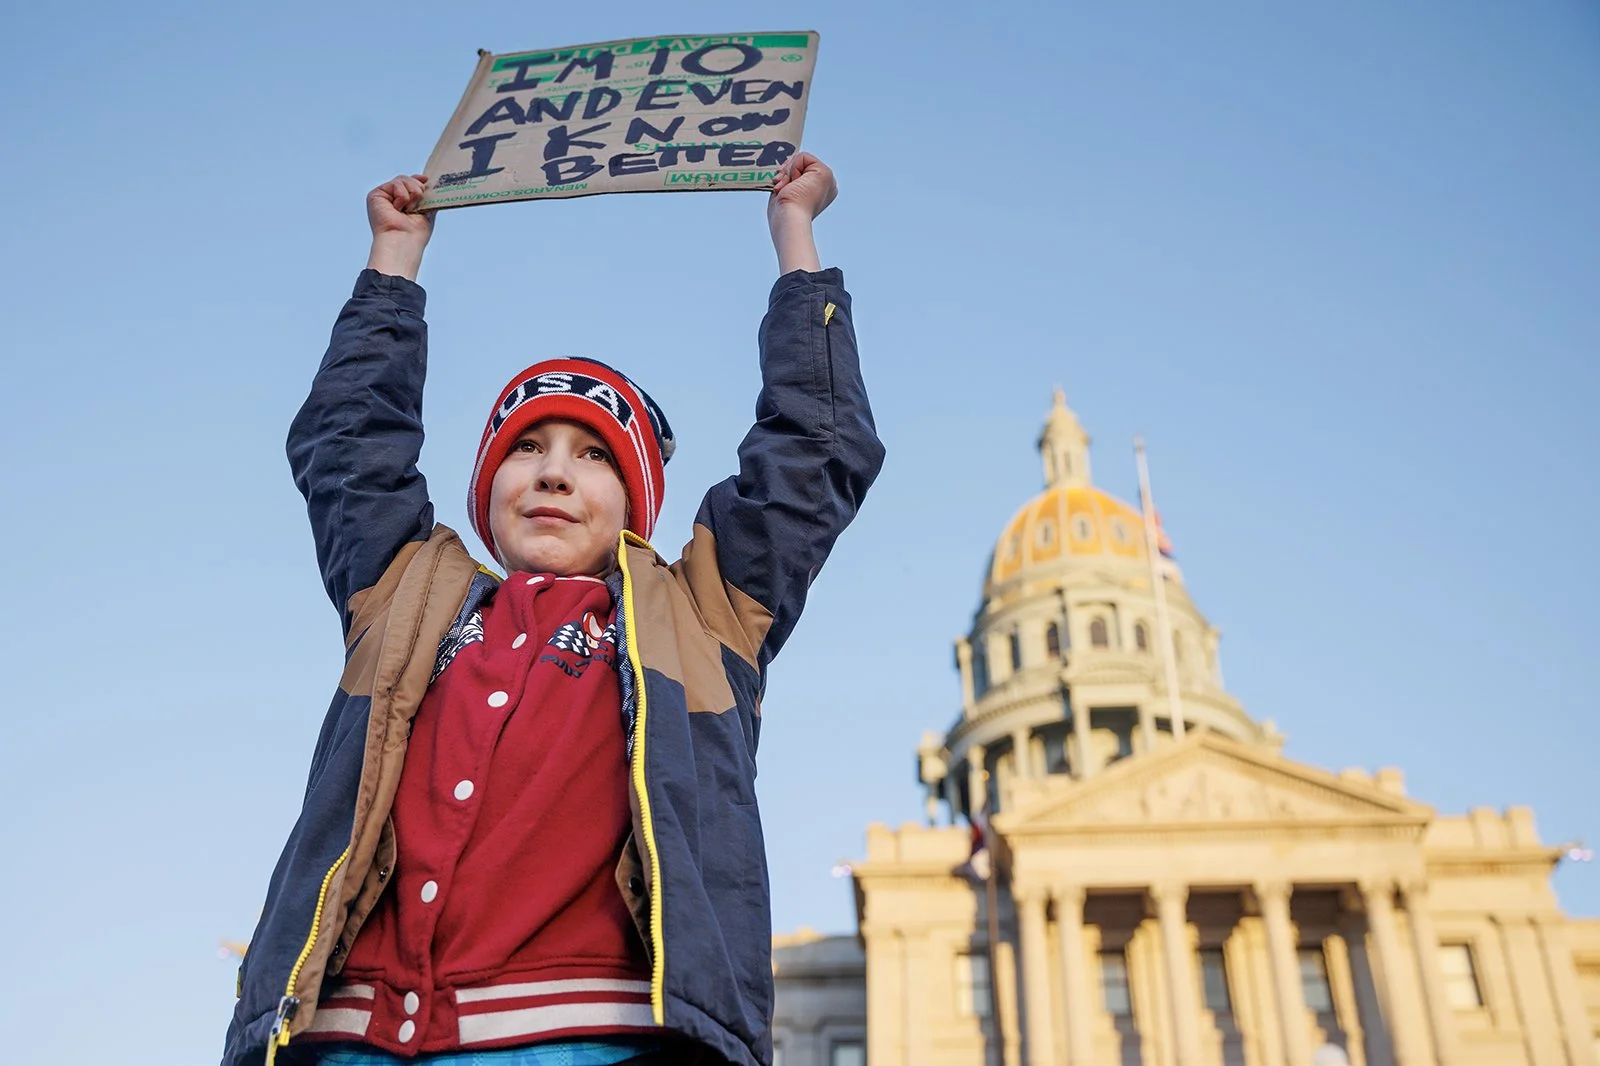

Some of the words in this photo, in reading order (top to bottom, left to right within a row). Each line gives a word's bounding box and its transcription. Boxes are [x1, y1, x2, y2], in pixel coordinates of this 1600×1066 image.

[641, 36, 753, 53] HEAVY
[495, 49, 613, 94] I'M
[465, 86, 622, 136] AND
[634, 78, 804, 112] EVEN
[460, 131, 517, 179] I
[541, 140, 796, 187] BETTER
[671, 171, 777, 184] MEDIUM
[500, 373, 620, 418] USA
